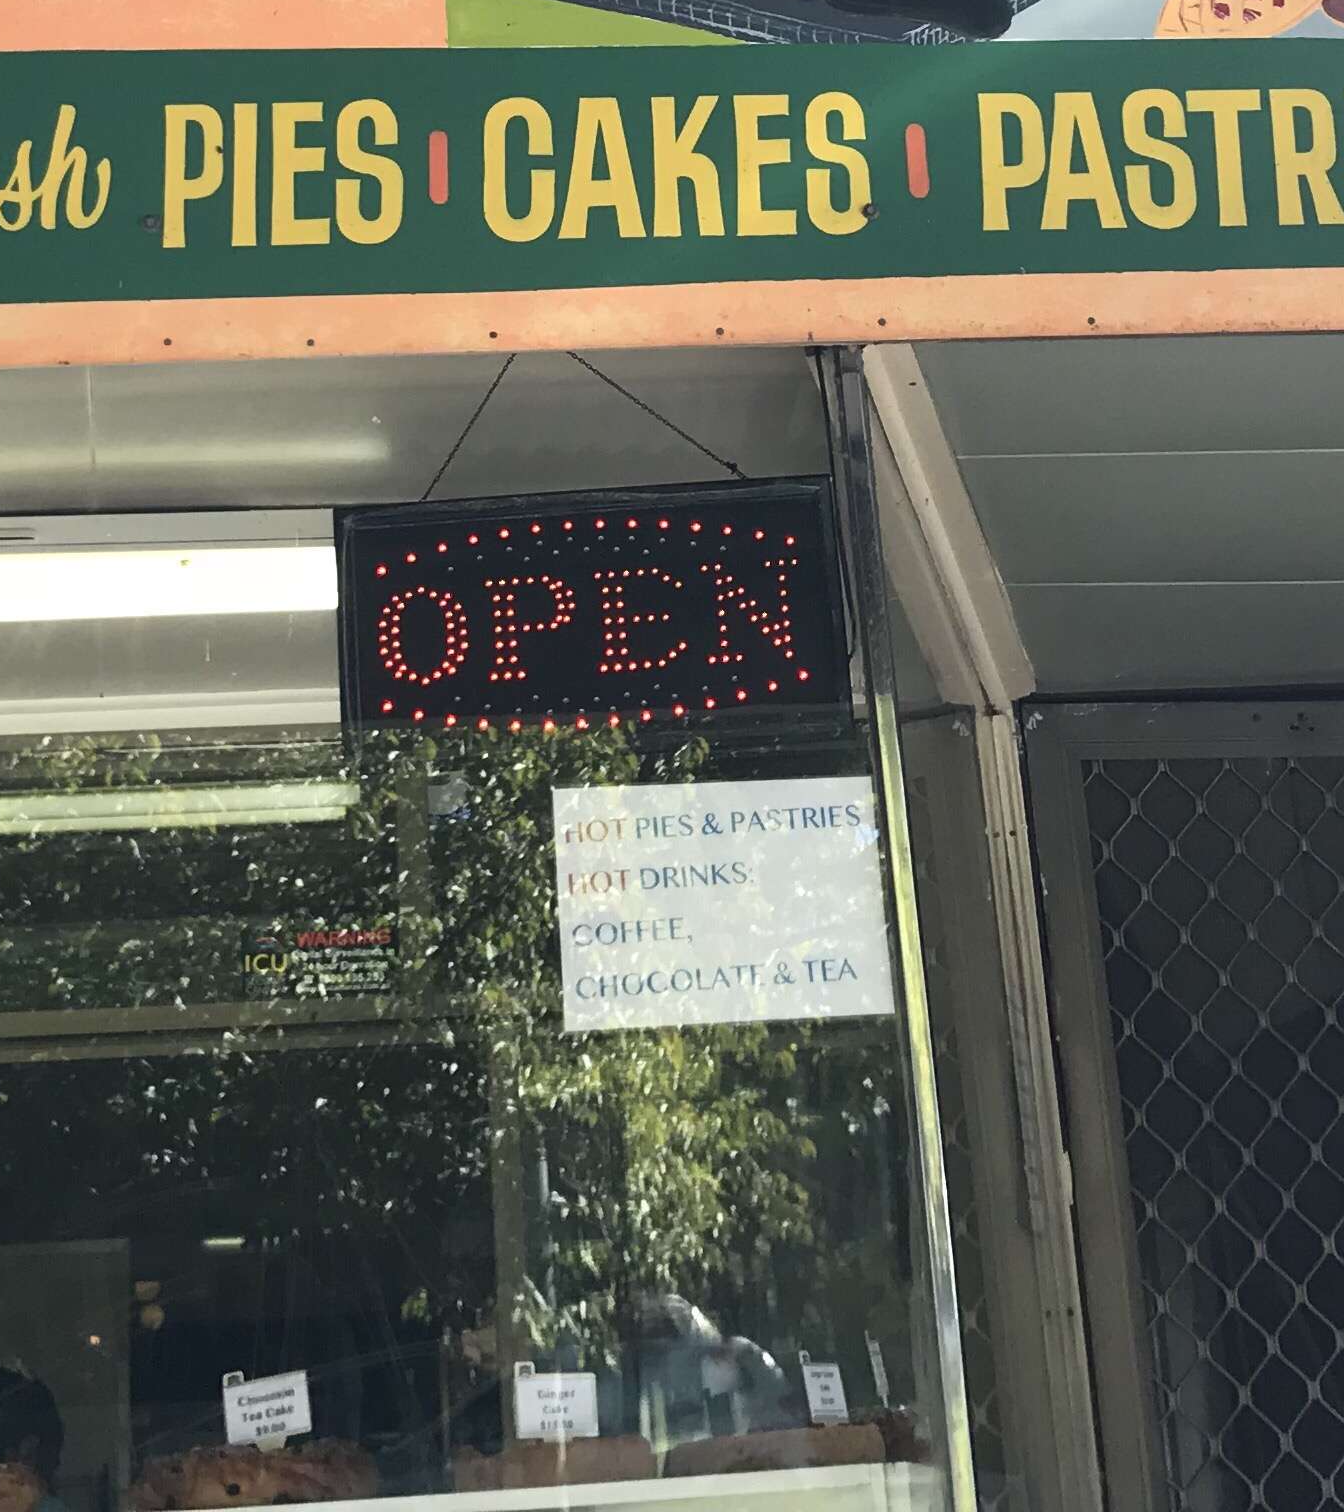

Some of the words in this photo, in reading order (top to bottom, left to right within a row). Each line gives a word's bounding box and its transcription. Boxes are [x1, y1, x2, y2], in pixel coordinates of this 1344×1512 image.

[162, 98, 403, 249] PIES
[483, 91, 870, 244] CAKES
[377, 557, 799, 687] OPEN
[565, 817, 627, 844] HOT
[635, 813, 693, 839] PIES
[701, 812, 724, 835] &
[730, 804, 862, 834] PASTRIES
[567, 868, 631, 895] HOT
[296, 928, 392, 948] WARNING
[243, 953, 289, 974] ICU
[574, 963, 765, 1000] CHOCOLATE
[773, 961, 796, 986] &
[802, 957, 858, 983] TEA
